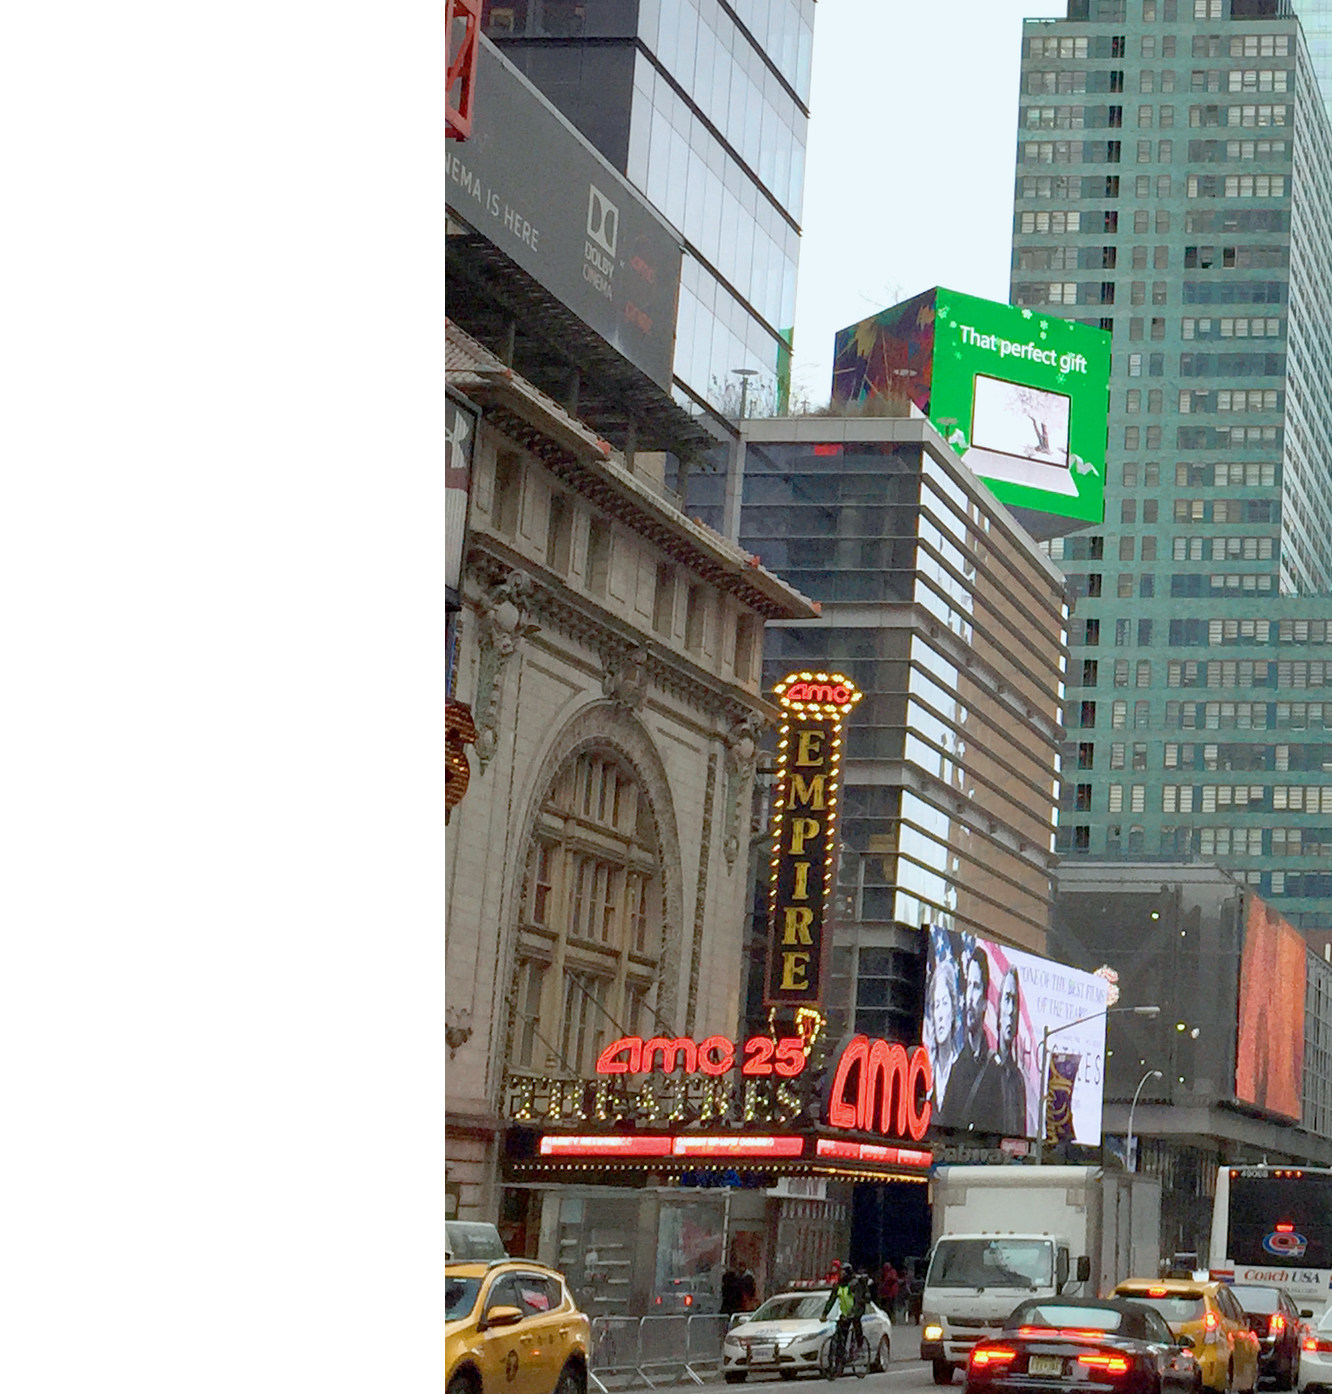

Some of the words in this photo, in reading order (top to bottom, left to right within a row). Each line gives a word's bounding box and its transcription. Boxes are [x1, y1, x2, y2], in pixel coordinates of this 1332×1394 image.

[486, 189, 499, 217] IS
[504, 203, 539, 252] HERE
[585, 240, 615, 278] DOLBY
[583, 264, 613, 301] CINEMA
[960, 325, 997, 351] That
[1000, 340, 1057, 367] perfect
[1060, 353, 1087, 374] gift
[780, 730, 827, 990] EMPIRE
[743, 1036, 806, 1076] 25
[1244, 1269, 1289, 1282] Coach
[1292, 1271, 1320, 1284] USA
